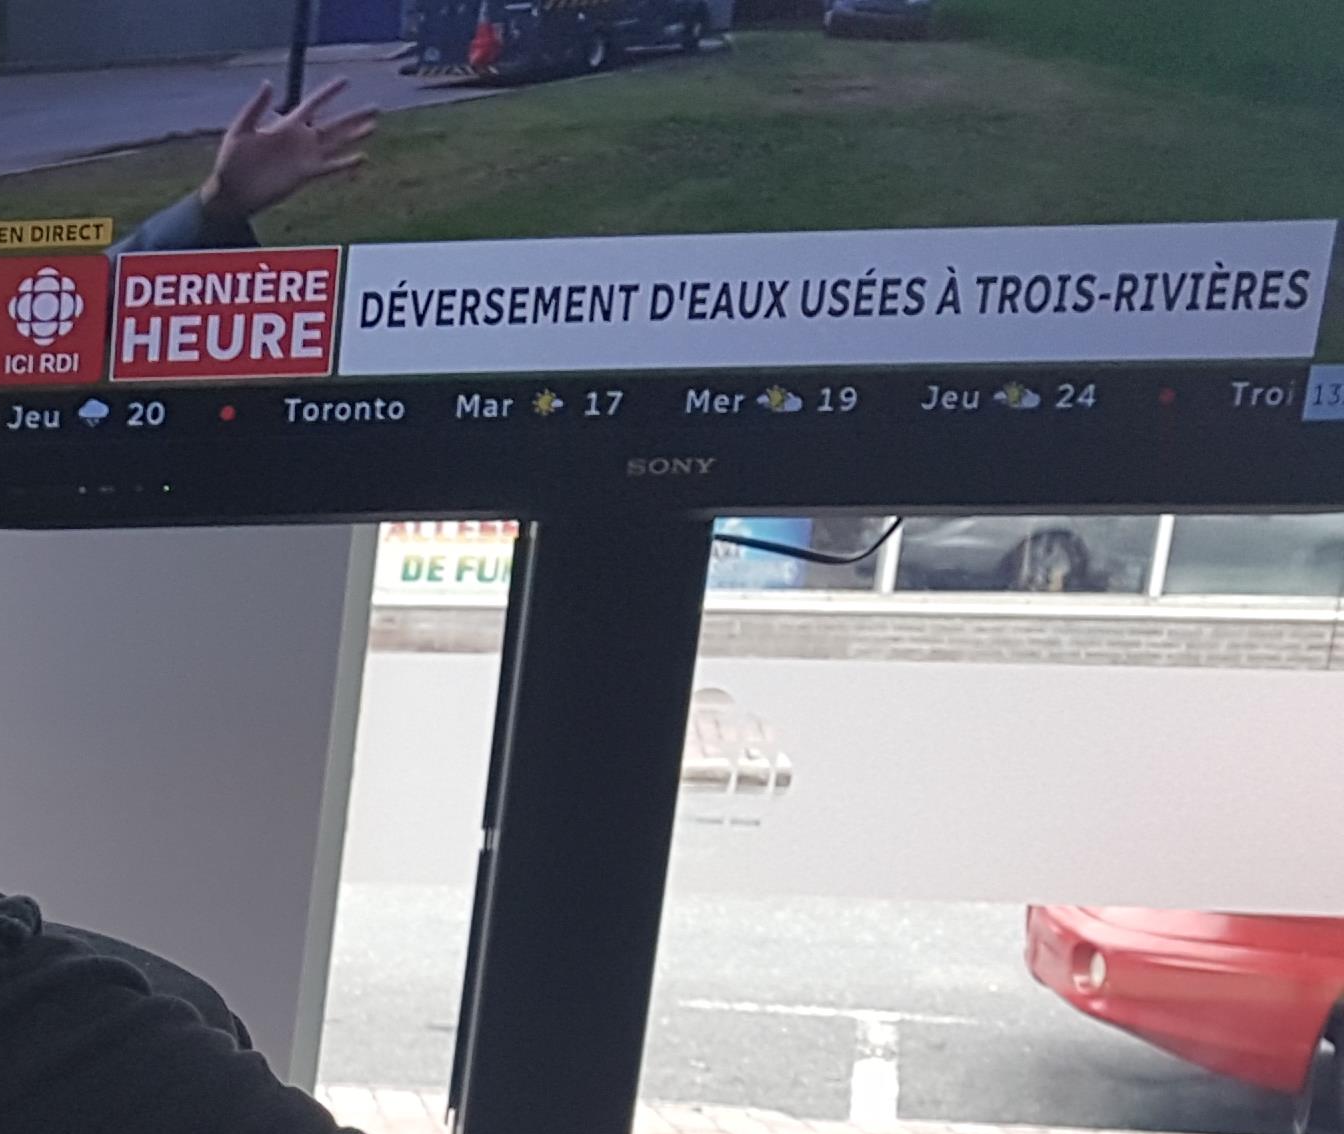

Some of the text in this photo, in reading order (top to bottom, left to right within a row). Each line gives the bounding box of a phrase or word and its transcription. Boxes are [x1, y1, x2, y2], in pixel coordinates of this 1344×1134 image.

[31, 224, 104, 242] DIRECT
[125, 263, 329, 308] DERNIÈRE
[360, 262, 1311, 328] DÉVERSEMENT D'EAUX USÉES À TROIS-RIVIÈRES
[121, 312, 326, 364] HEURE
[5, 353, 79, 374] ICI RDI
[7, 405, 60, 429] Jeu
[127, 401, 165, 426] 20
[285, 397, 406, 423] Toronto
[456, 394, 513, 418] Mar
[584, 391, 624, 417] 17
[685, 389, 745, 414] Mer
[818, 387, 858, 412] 19
[921, 385, 980, 411] Jeu
[1055, 384, 1097, 409] 24
[626, 457, 716, 477] SONY
[401, 555, 444, 583] DE
